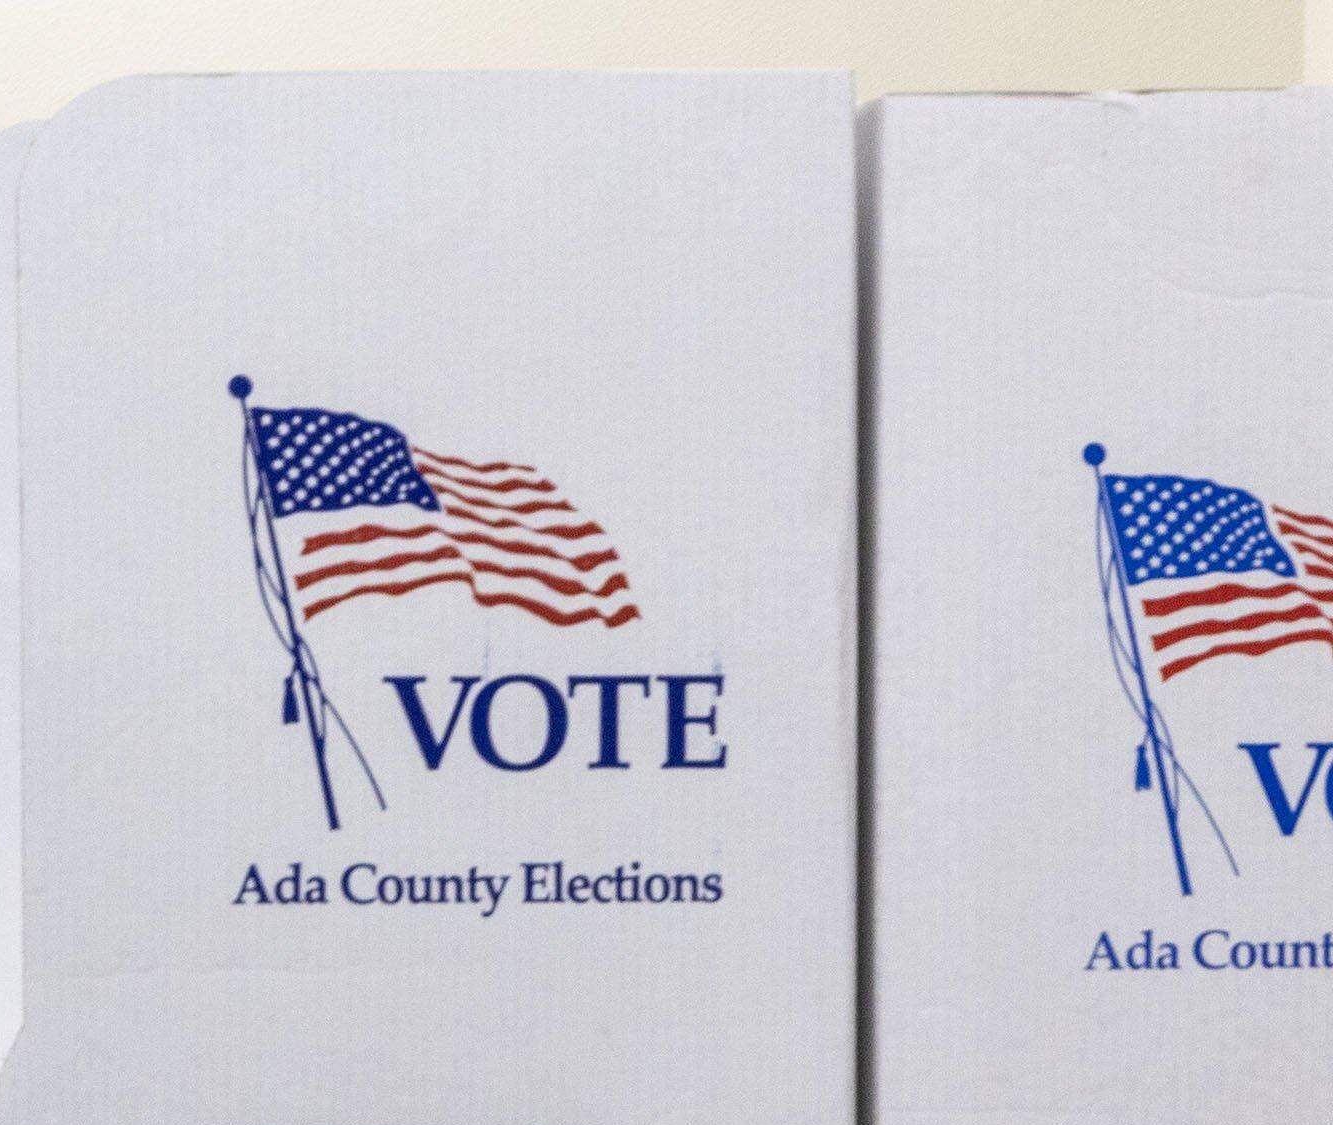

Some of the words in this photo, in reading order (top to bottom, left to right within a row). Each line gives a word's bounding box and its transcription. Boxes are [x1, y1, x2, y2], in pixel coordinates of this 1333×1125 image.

[382, 674, 728, 771] VOTE
[232, 862, 328, 905] Ada
[339, 862, 510, 918] County
[520, 860, 724, 904] Elections
[1084, 929, 1181, 971] Ada
[1191, 929, 1333, 971] Count
